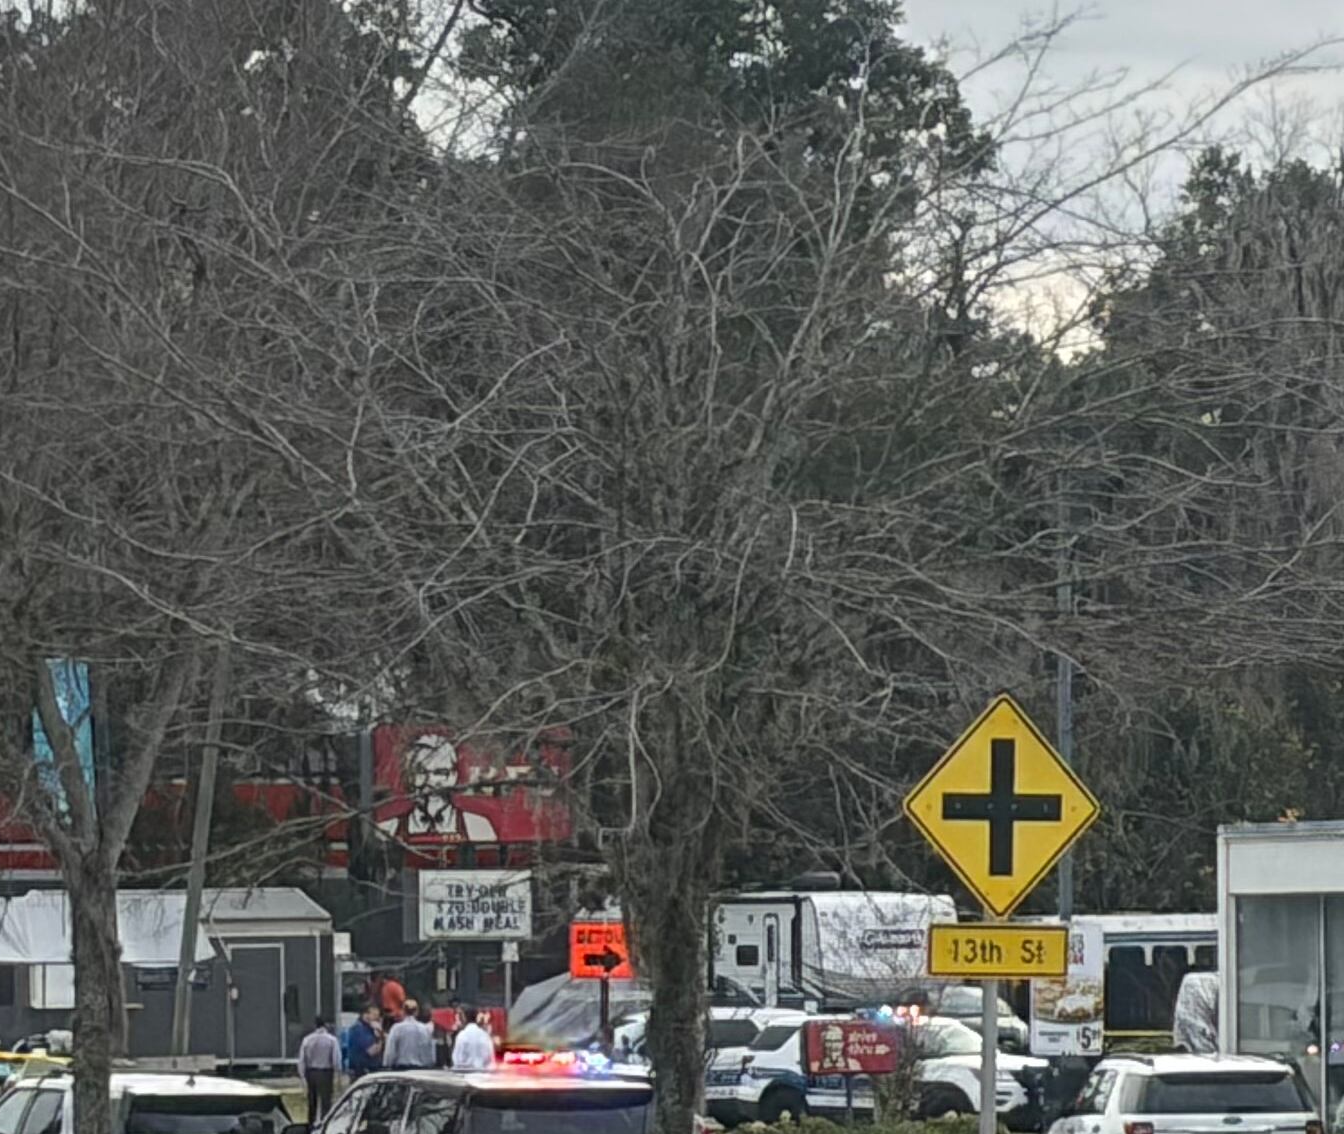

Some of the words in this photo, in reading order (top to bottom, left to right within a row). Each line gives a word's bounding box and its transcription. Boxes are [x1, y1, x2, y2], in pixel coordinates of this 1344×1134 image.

[464, 765, 561, 796] KF
[446, 884, 474, 898] TRY
[576, 929, 624, 945] DETOU
[949, 938, 1003, 964] 13th
[1019, 939, 1045, 964] St
